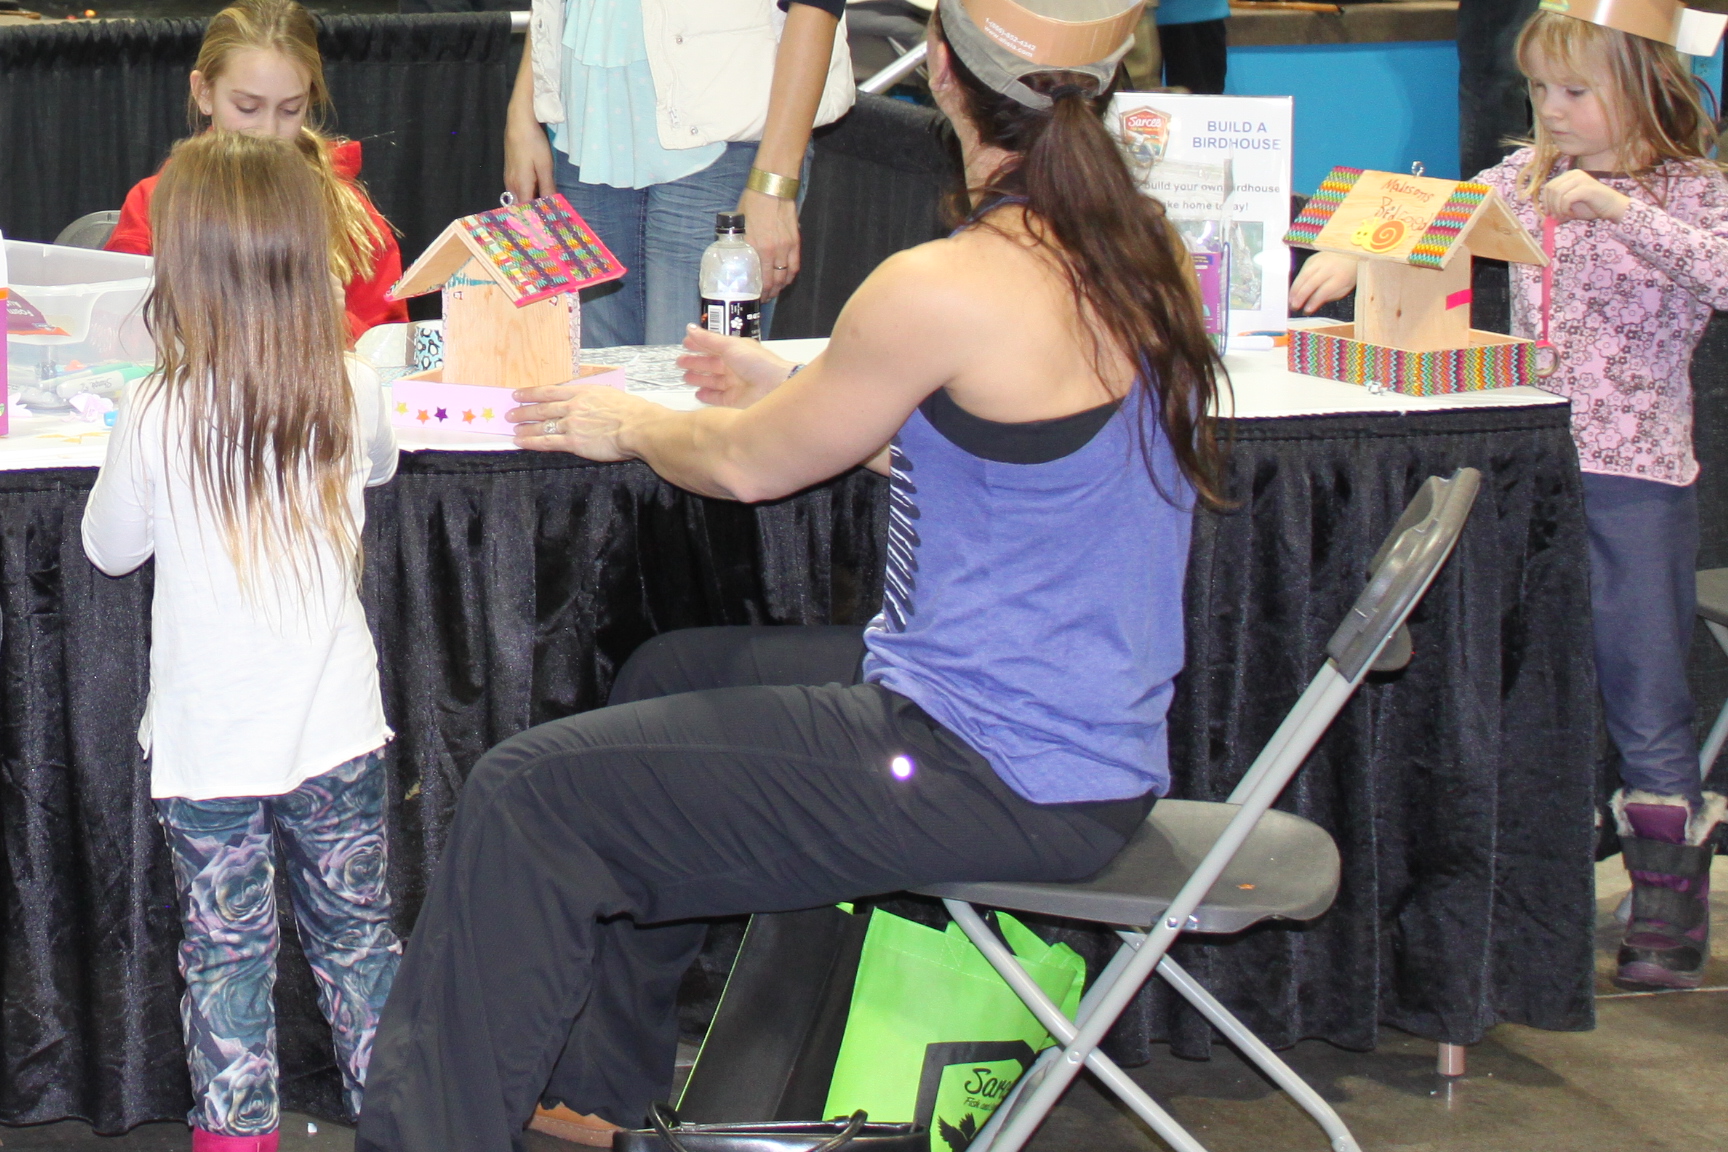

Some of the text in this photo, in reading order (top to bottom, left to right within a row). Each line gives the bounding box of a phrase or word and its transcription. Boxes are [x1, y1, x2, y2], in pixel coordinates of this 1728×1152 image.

[1127, 116, 1162, 128] Sarcee
[1207, 120, 1267, 133] BUILD A
[1192, 137, 1281, 150] BIRDHOUSE
[1173, 184, 1198, 193] your
[1201, 184, 1223, 192] own
[1226, 183, 1280, 193] rdhouse
[1183, 201, 1211, 210] home
[1215, 202, 1249, 212] tay!
[964, 1067, 1012, 1099] Sar
